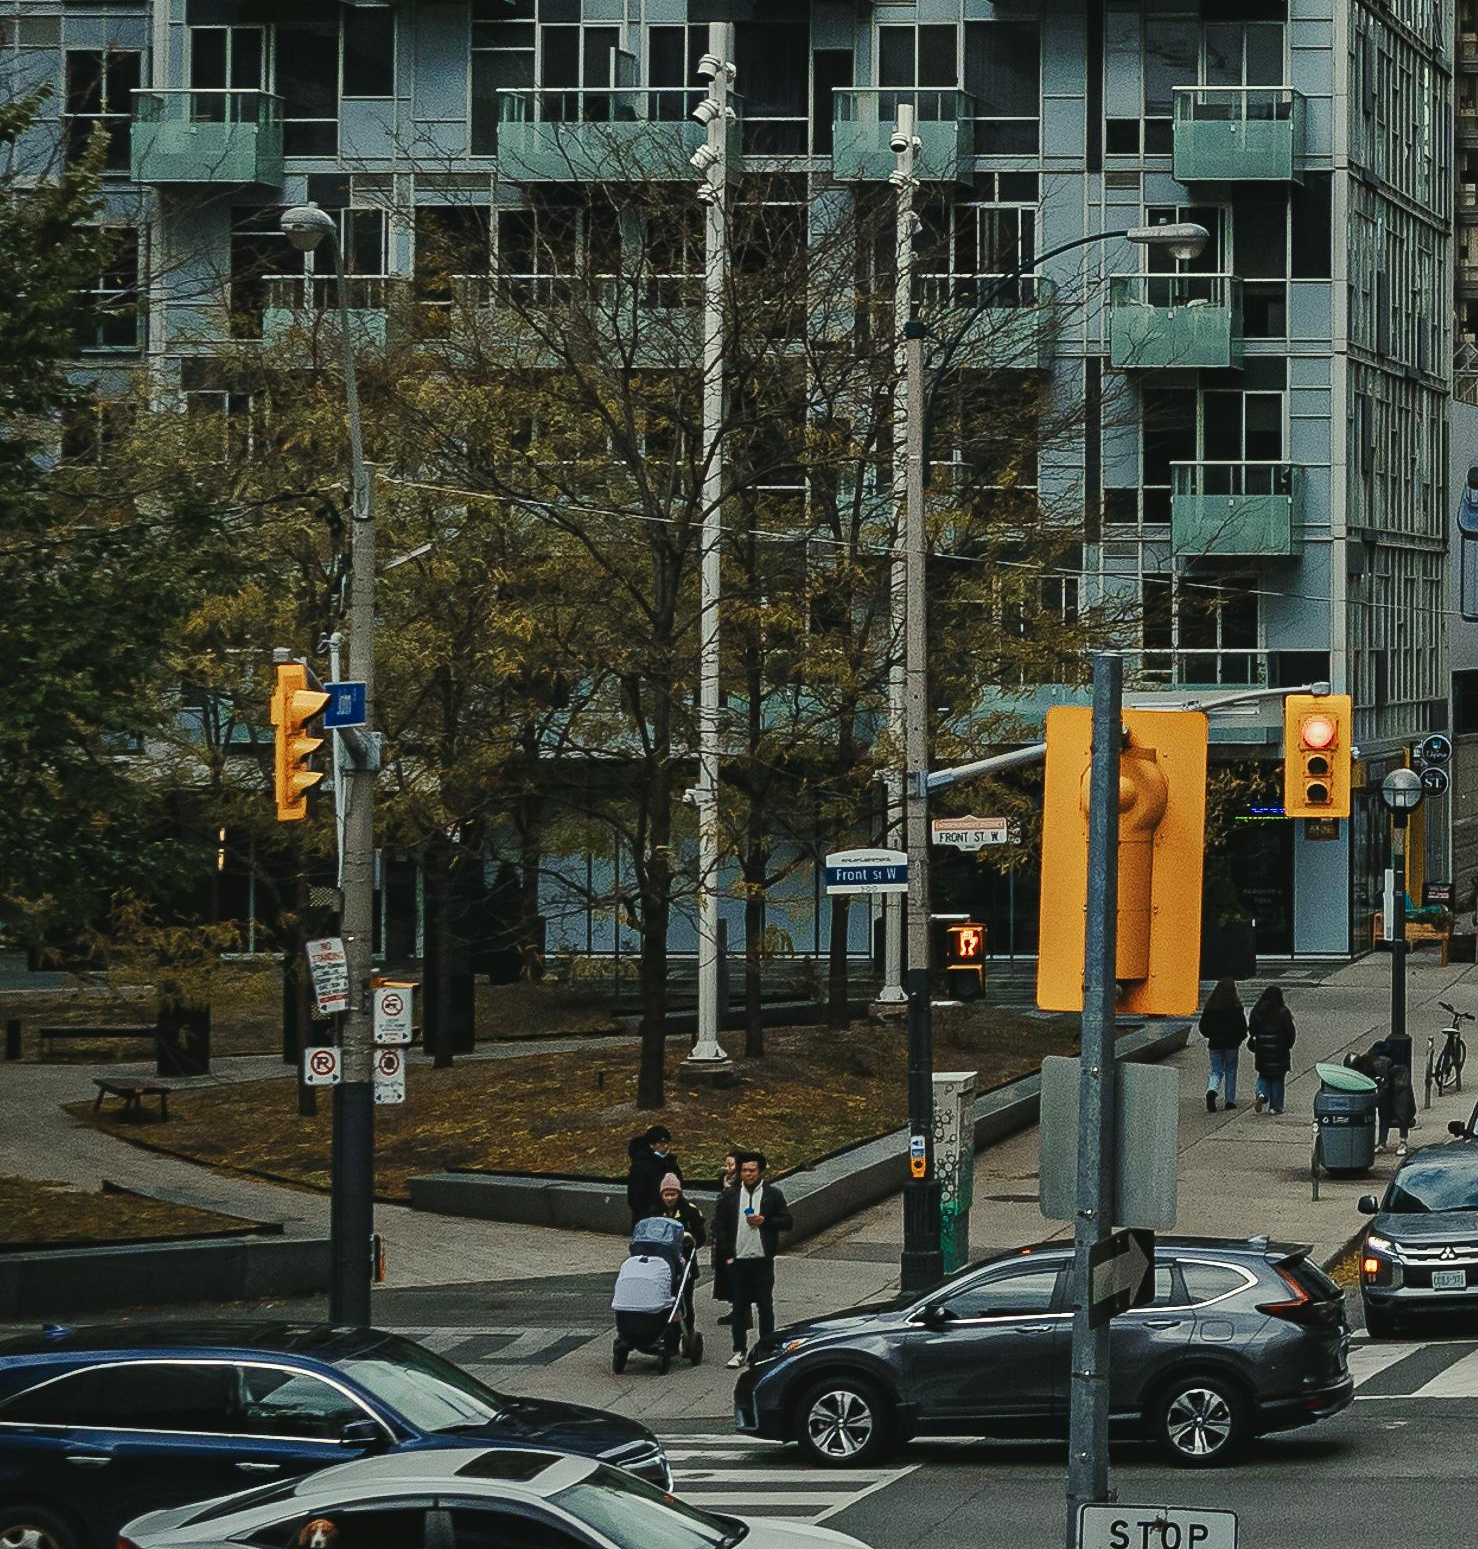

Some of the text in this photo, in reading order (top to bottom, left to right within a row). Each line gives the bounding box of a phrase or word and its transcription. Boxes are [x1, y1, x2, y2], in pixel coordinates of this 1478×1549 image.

[939, 831, 968, 843] FRONT
[836, 867, 867, 880] Front
[886, 867, 896, 879] W
